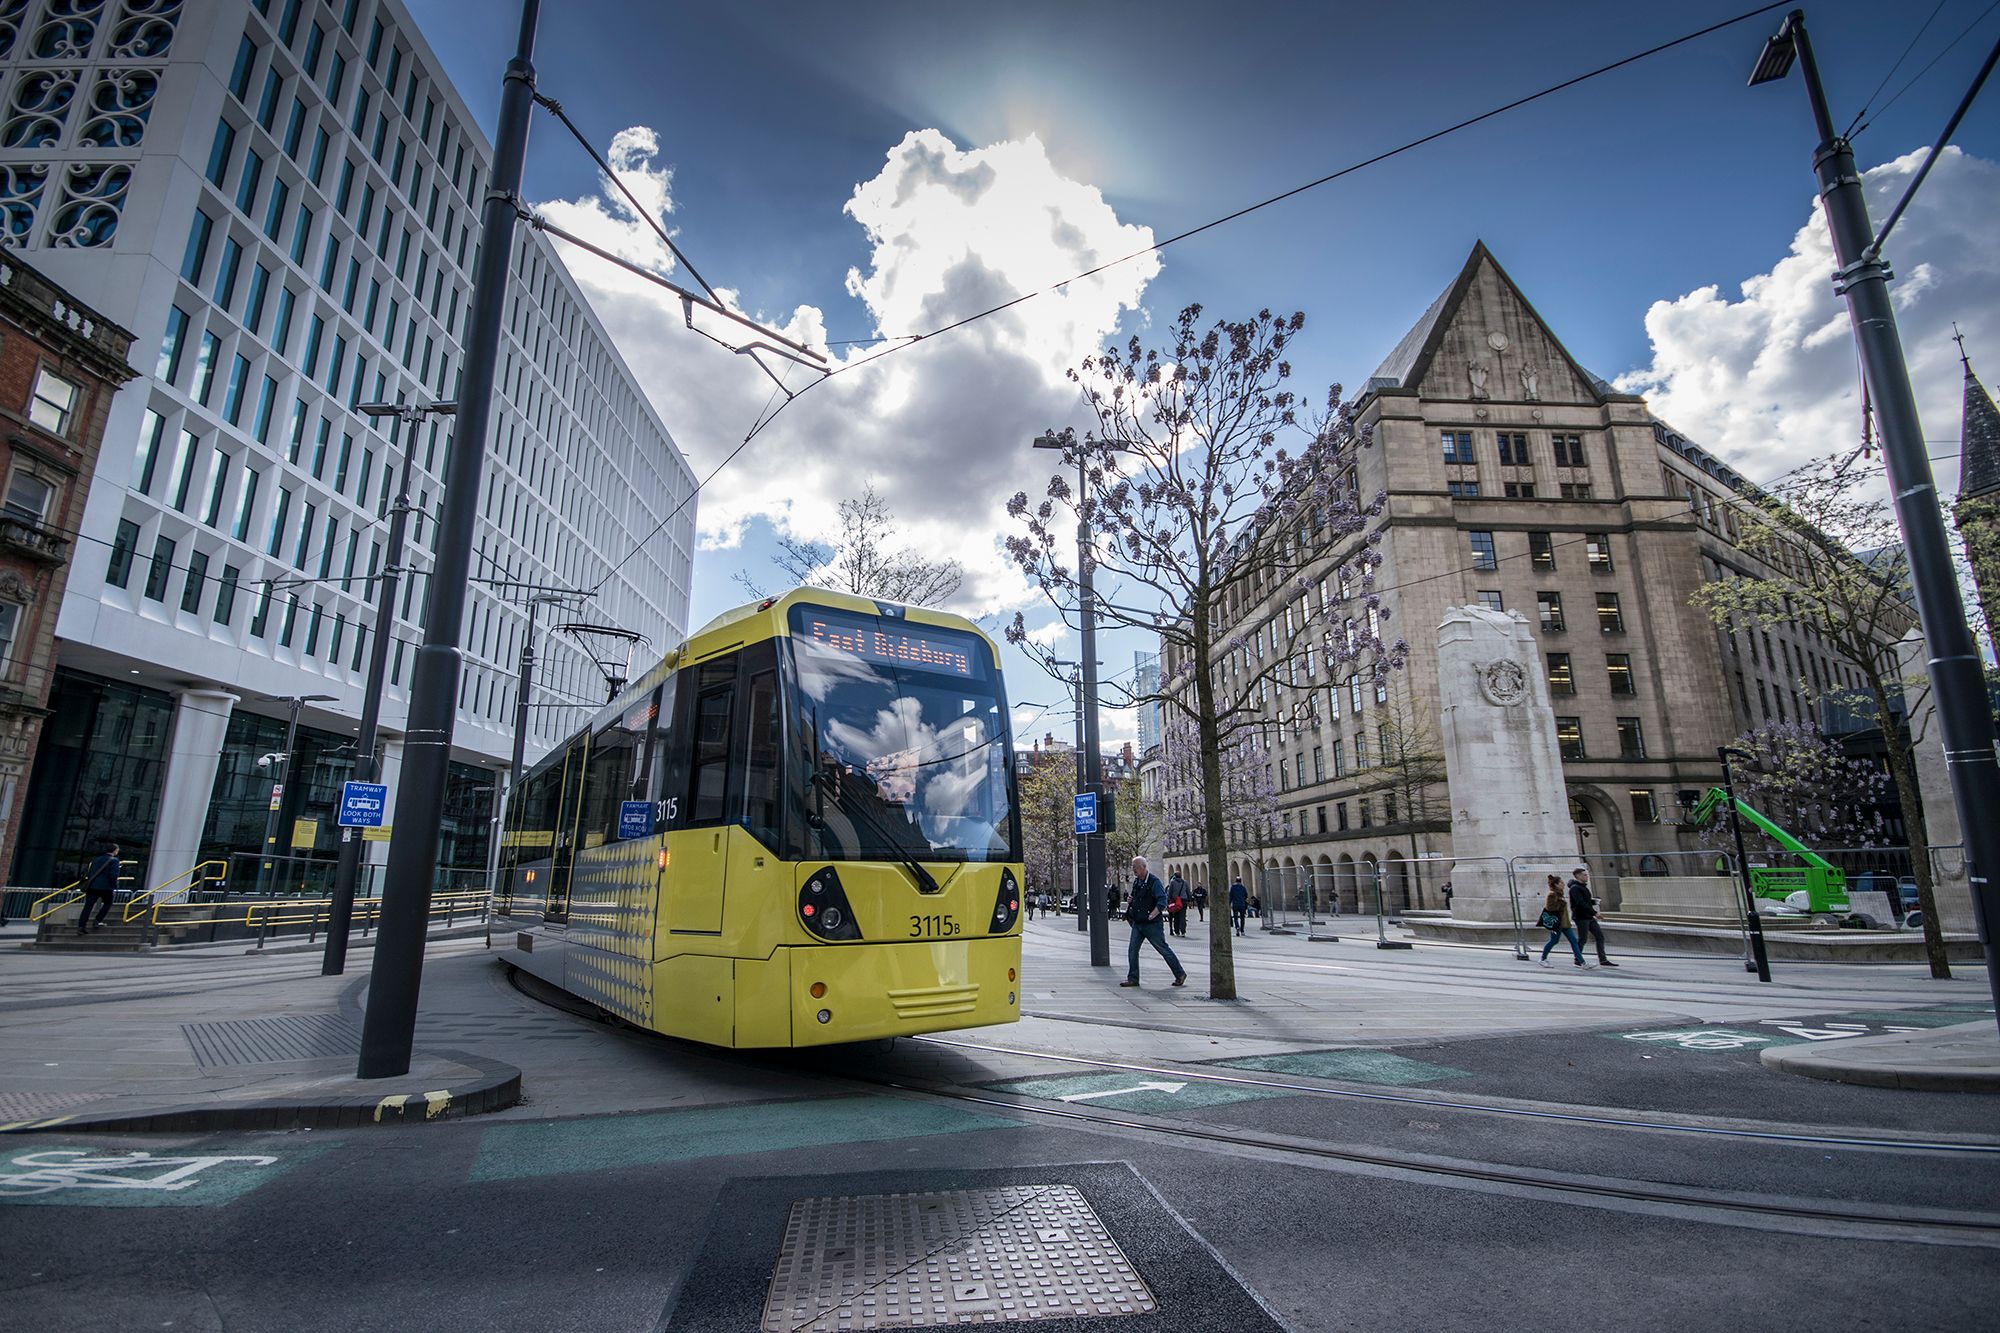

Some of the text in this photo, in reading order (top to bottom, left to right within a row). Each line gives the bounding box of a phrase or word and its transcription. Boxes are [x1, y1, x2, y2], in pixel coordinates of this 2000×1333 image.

[813, 622, 967, 673] East Didsbury
[350, 785, 382, 793] TRAMWAY
[343, 810, 381, 819] LOOK BOTH
[656, 797, 678, 822] 3115
